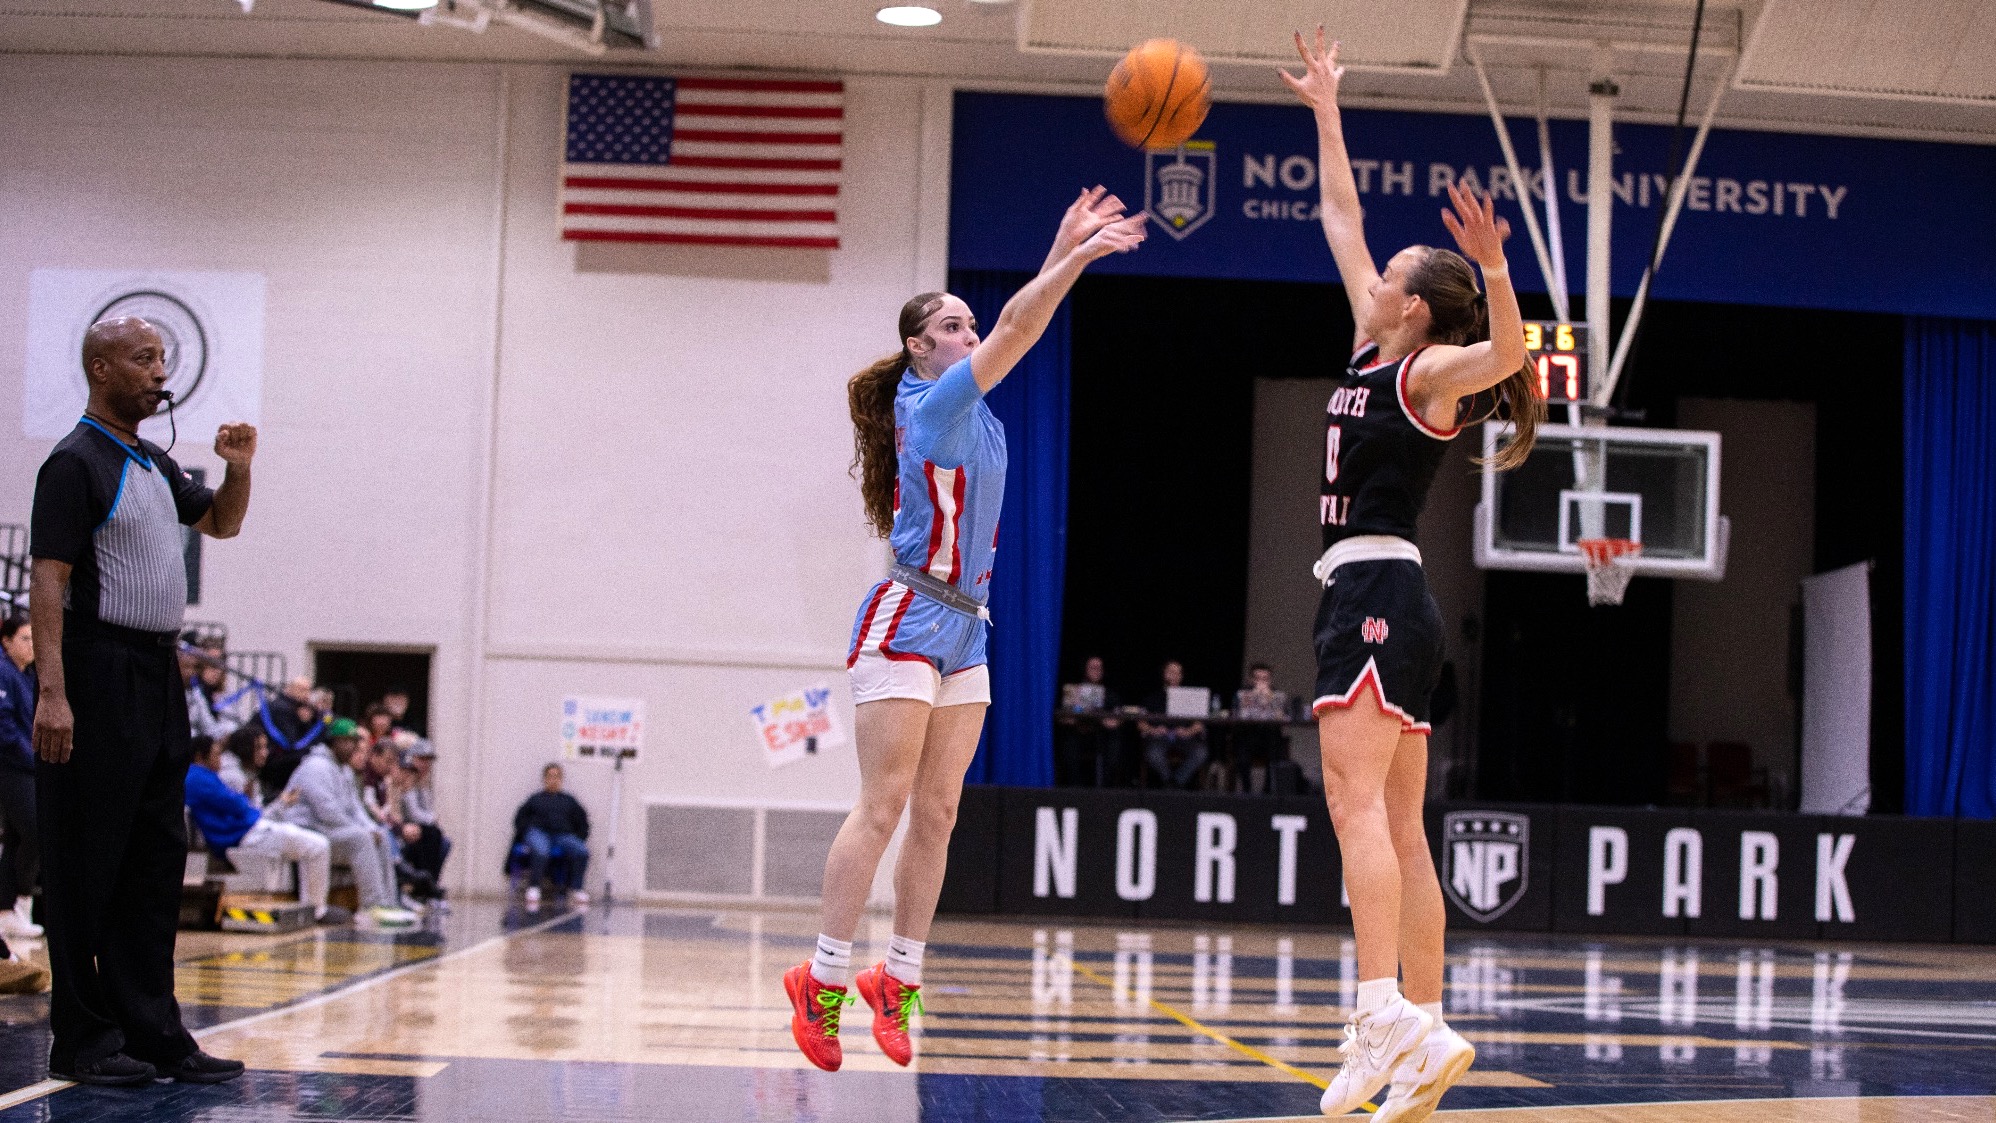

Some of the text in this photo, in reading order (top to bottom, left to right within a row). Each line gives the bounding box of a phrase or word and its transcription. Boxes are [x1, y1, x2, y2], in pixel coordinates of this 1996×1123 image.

[1243, 153, 1414, 196] NOTH
[1428, 162, 1549, 203] PARK
[1242, 199, 1366, 221] CHICA
[1538, 354, 1578, 401] 17
[1033, 806, 1856, 924] NORT PARK
[1452, 840, 1520, 911] NP
